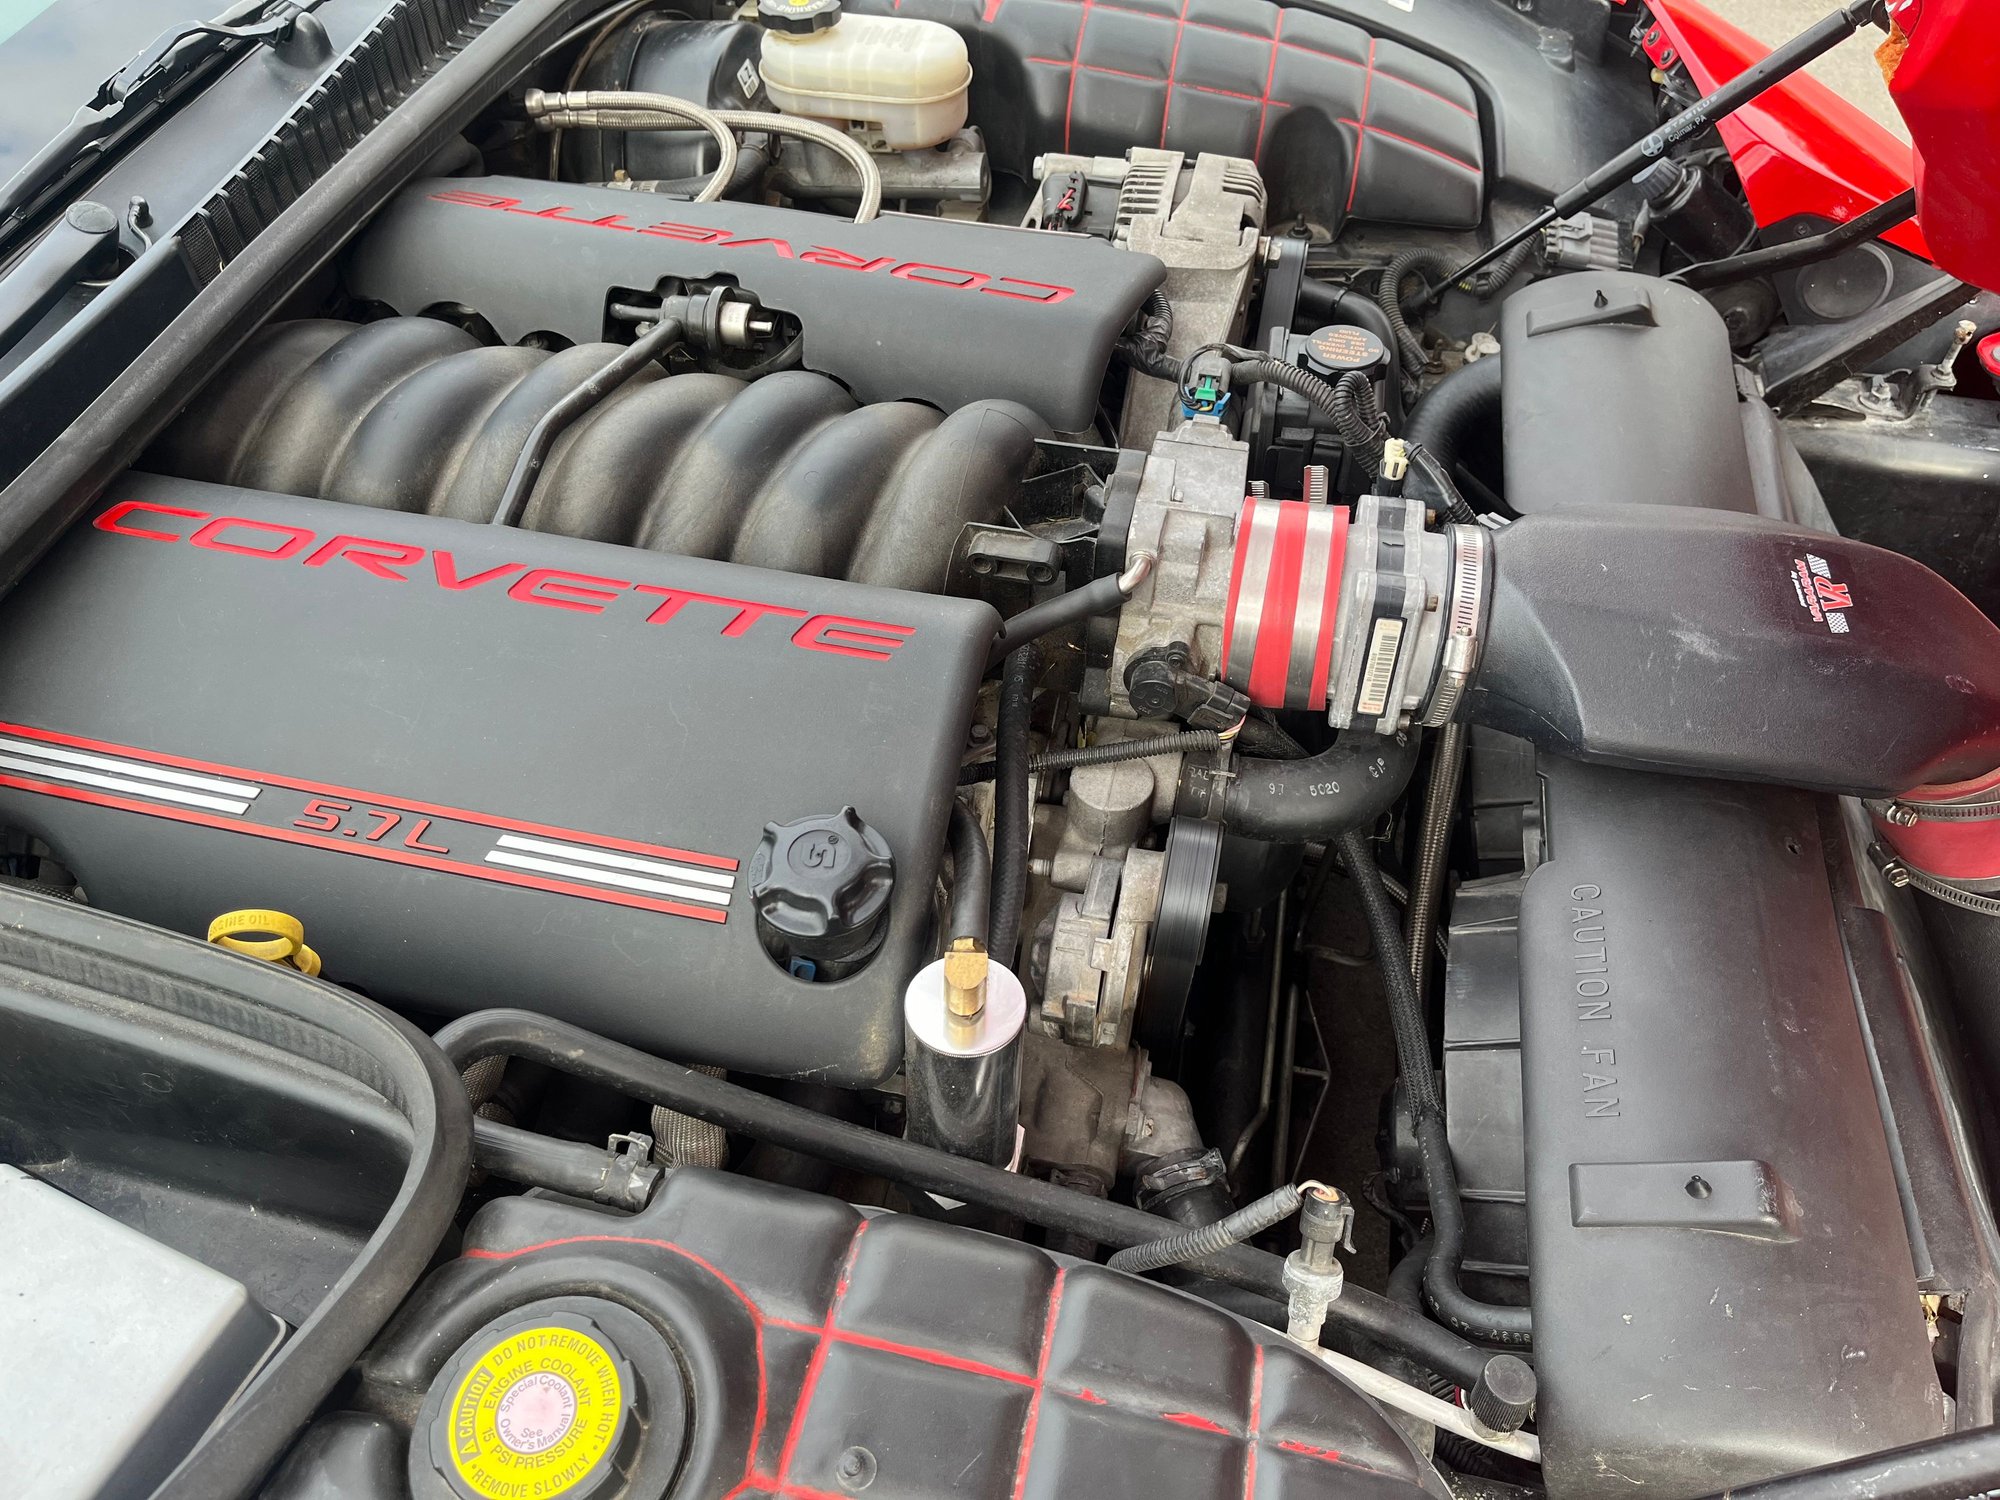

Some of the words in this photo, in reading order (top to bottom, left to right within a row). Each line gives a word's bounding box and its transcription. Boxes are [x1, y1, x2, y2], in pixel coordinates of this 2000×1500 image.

[1694, 114, 1708, 126] PA
[429, 190, 1076, 304] CORVETTE
[1318, 345, 1369, 358] STEERING
[1322, 352, 1361, 363] POWER
[92, 500, 917, 662] CORVETTE
[1309, 780, 1341, 797] 5020
[293, 799, 450, 854] 5.7L
[248, 914, 270, 926] OIL
[1570, 883, 1613, 1021] CAUTION
[1580, 1048, 1621, 1118] FAN
[492, 1347, 514, 1368] DO
[516, 1334, 547, 1354] NOT
[548, 1333, 603, 1368] REMOVE
[484, 1359, 535, 1410] ENGINE
[540, 1357, 593, 1408] COOLANT
[501, 1376, 538, 1413] Special
[539, 1375, 574, 1410] Coolant
[596, 1364, 617, 1408] WHEN
[459, 1372, 492, 1439] CAUTION
[481, 1426, 497, 1443] 15
[490, 1444, 513, 1467] PSI
[513, 1418, 589, 1470] PRESSURE
[500, 1418, 536, 1451] Owner's
[536, 1413, 572, 1449] Manual
[521, 1427, 544, 1440] See
[594, 1412, 616, 1445] HOT
[471, 1467, 529, 1498] REMOVE
[534, 1453, 591, 1495] SLOWLY
